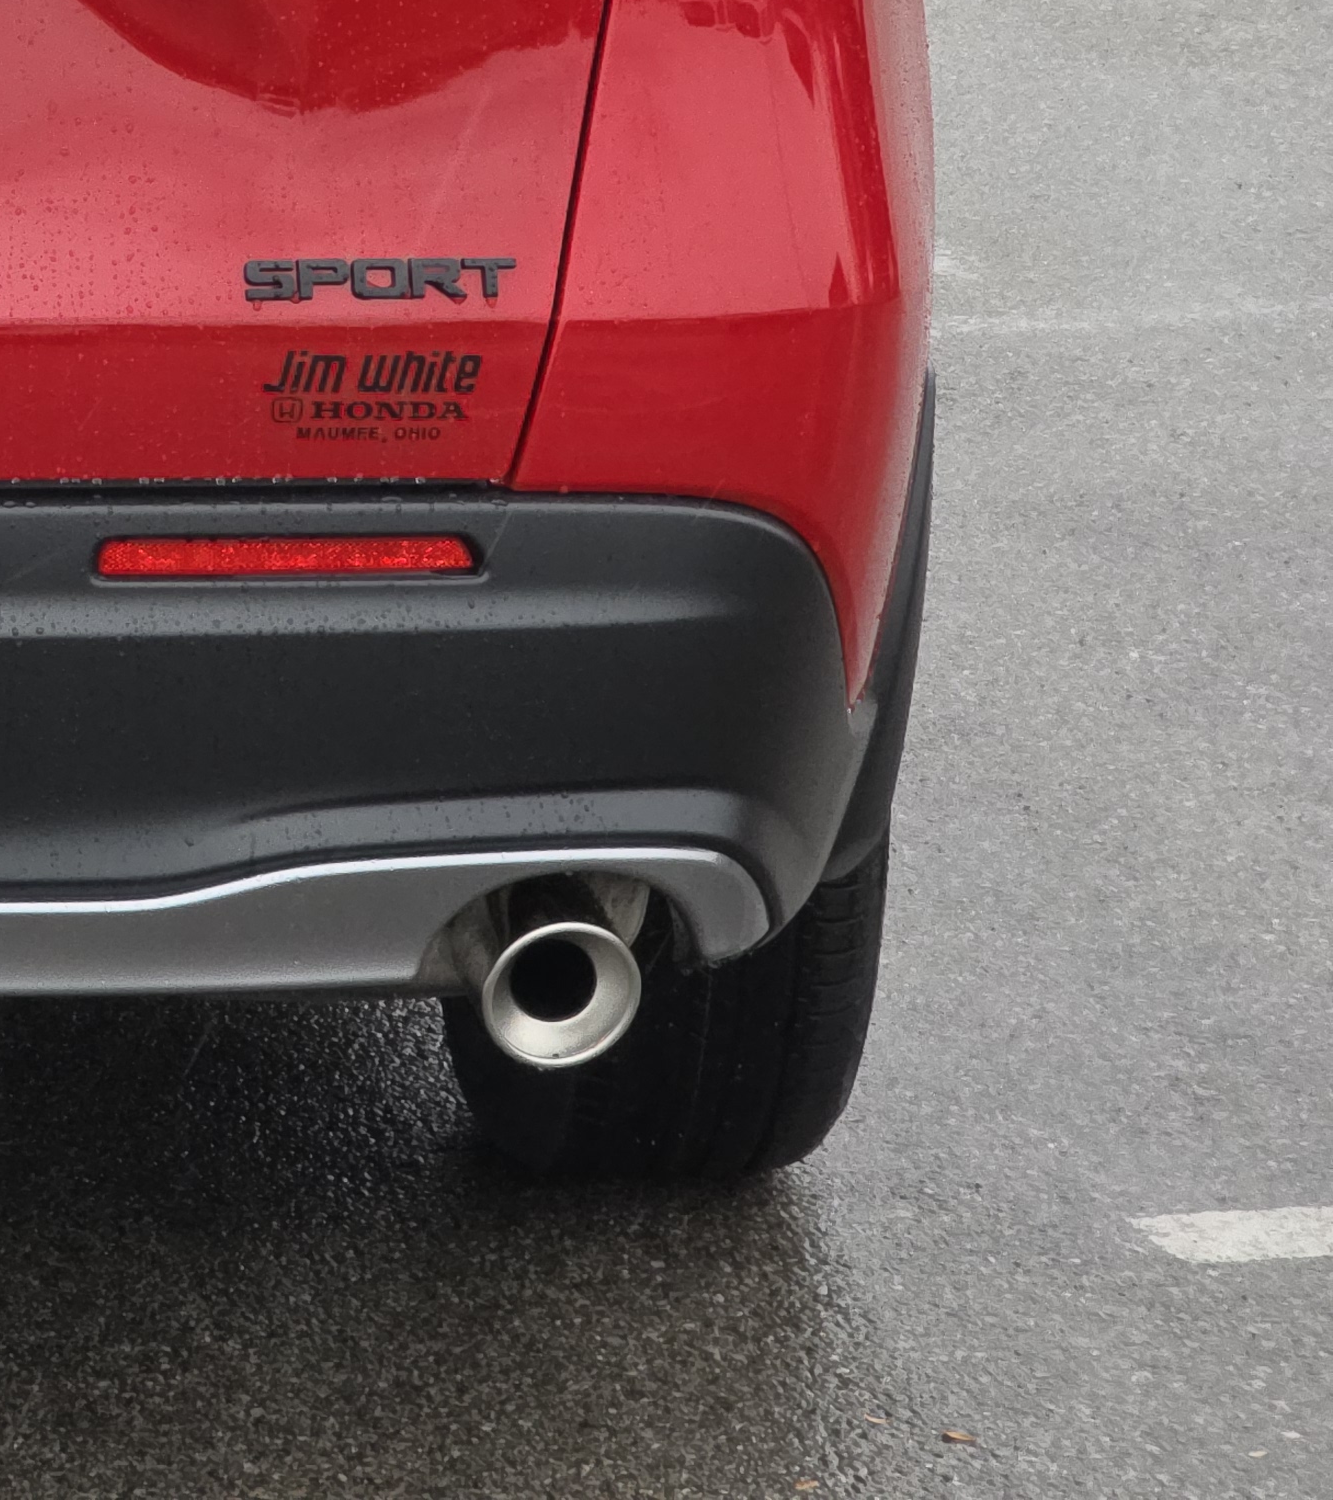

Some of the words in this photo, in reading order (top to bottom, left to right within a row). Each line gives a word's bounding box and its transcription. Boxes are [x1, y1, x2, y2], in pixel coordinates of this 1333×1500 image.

[243, 257, 518, 301] SPORT
[263, 350, 348, 394] Jim
[311, 400, 468, 421] HONDA
[394, 426, 441, 441] OHIO
